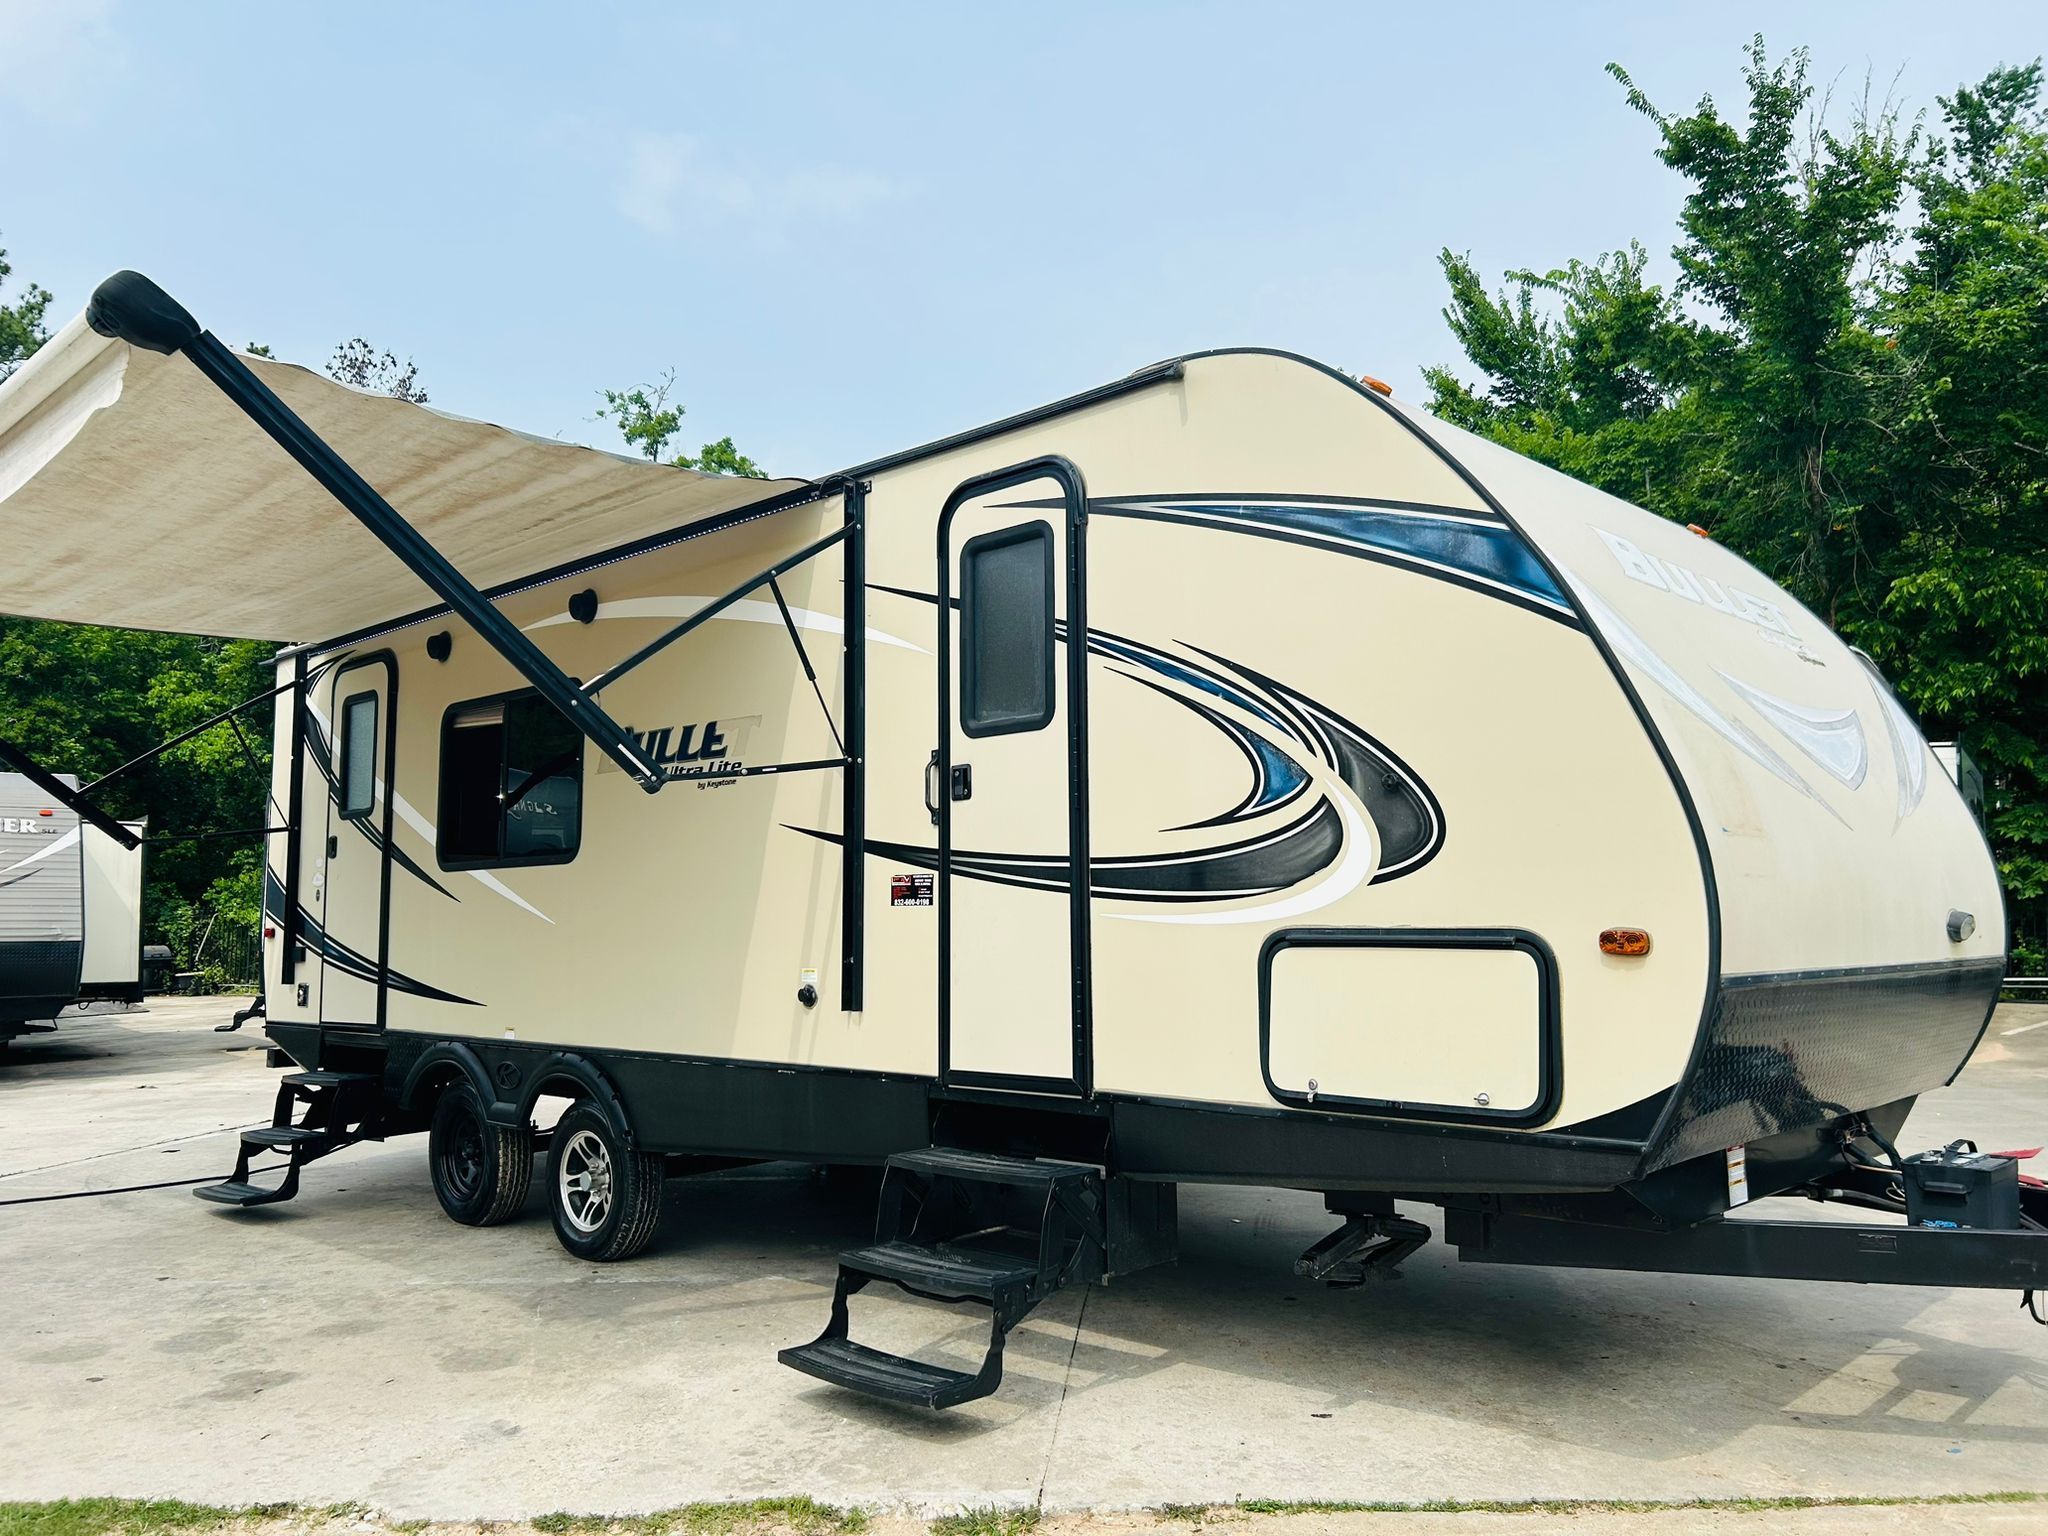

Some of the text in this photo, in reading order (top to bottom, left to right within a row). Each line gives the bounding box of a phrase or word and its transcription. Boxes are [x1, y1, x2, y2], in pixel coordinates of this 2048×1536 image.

[708, 760, 742, 772] Lite
[707, 779, 737, 788] Keystone
[0, 817, 39, 833] ER
